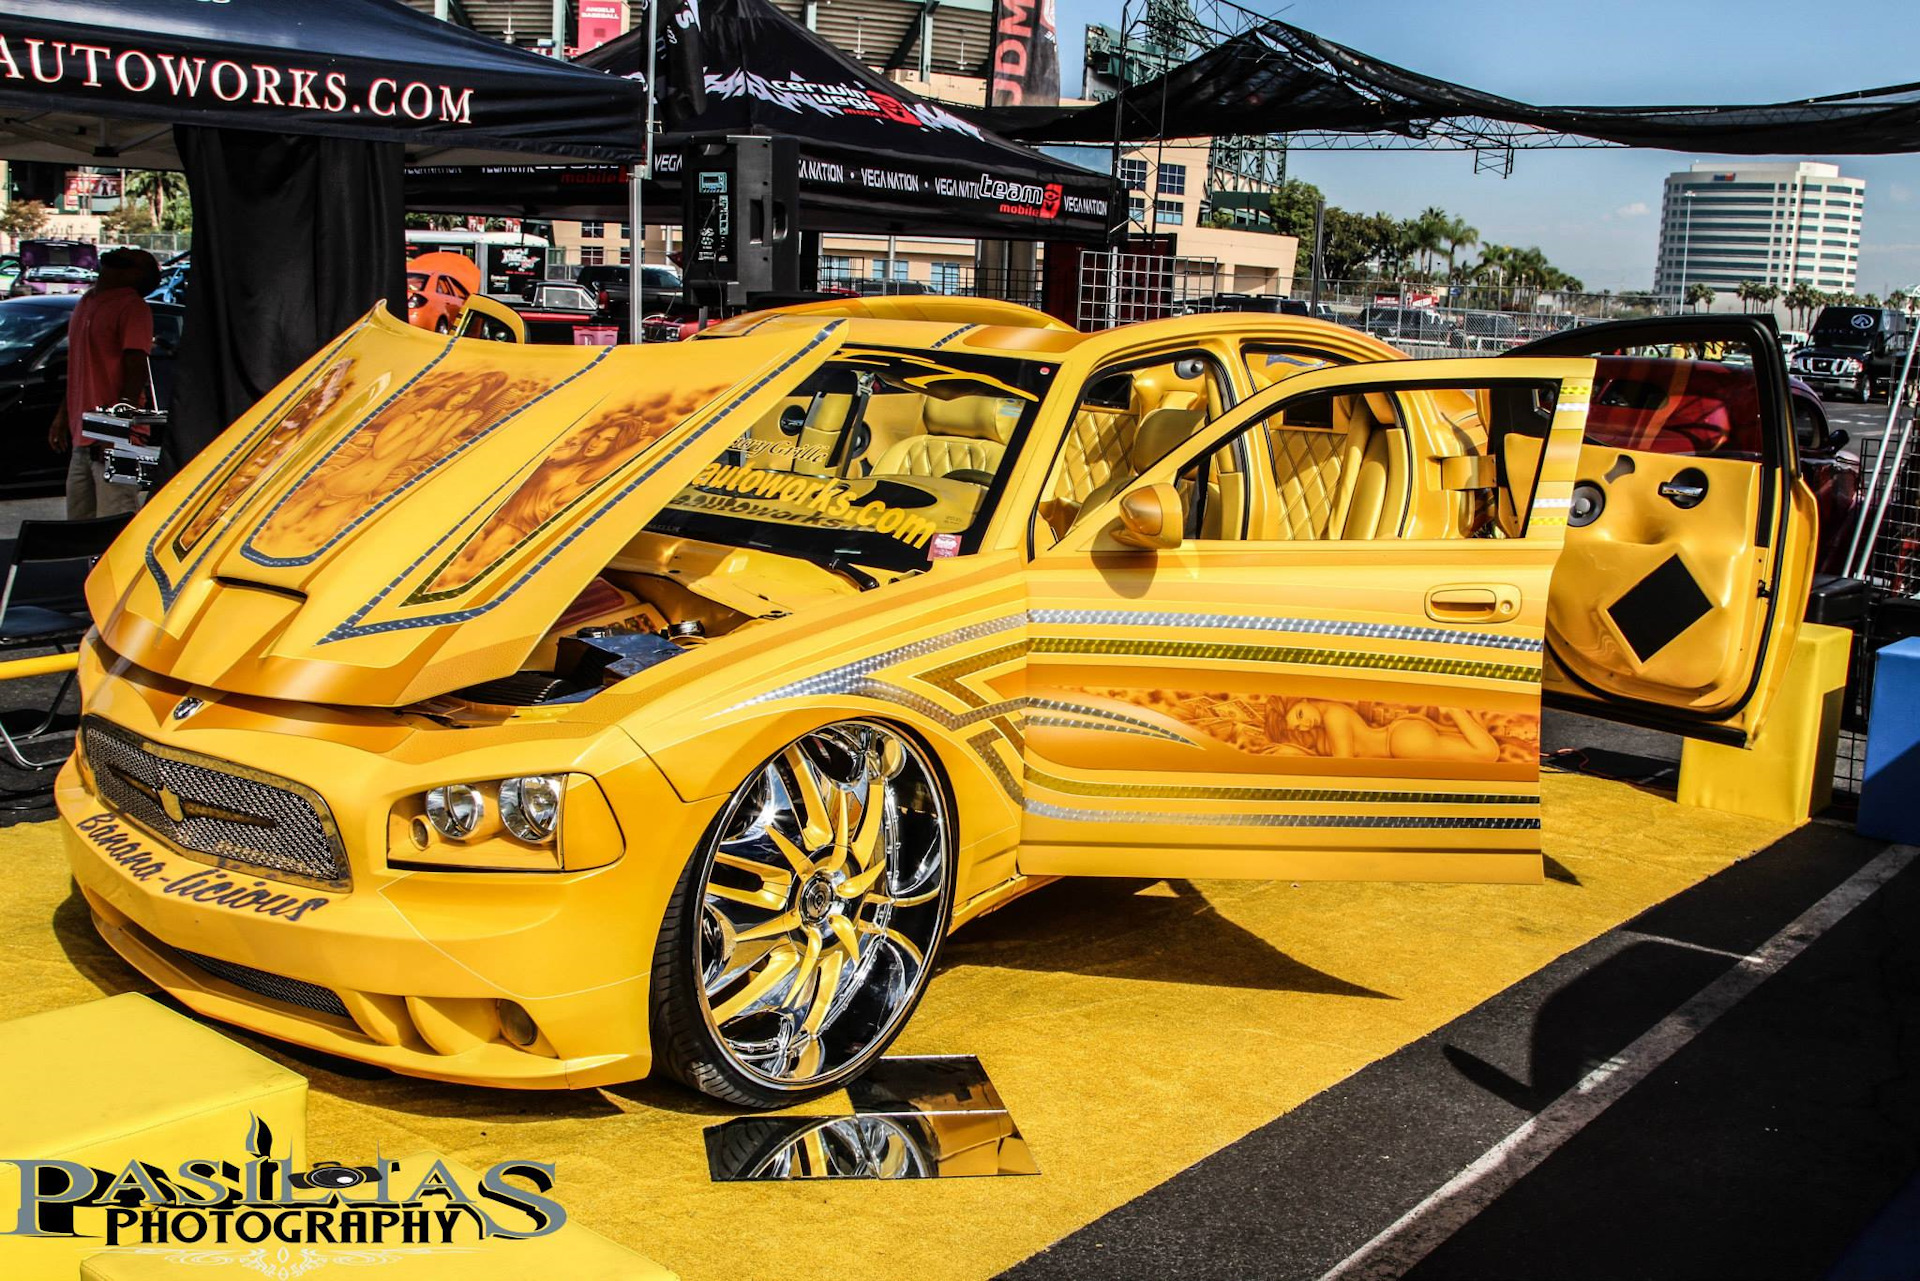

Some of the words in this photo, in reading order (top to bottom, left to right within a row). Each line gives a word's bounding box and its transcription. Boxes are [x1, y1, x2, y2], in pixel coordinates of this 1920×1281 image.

[0, 34, 474, 124] AUTOWORKS.COM
[771, 79, 870, 100] cerwin
[980, 173, 1044, 205] team
[999, 203, 1040, 218] mobile
[769, 440, 831, 464] Grille
[691, 461, 937, 550] autoworks.com
